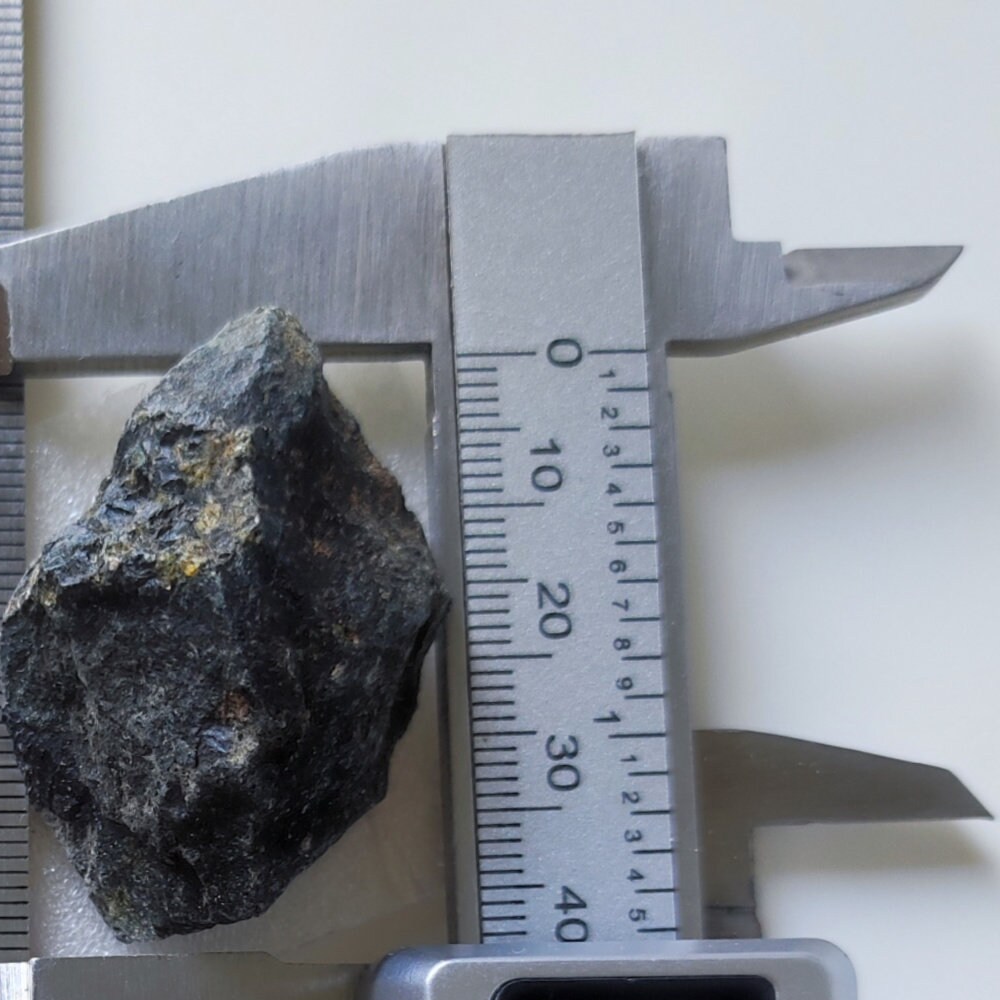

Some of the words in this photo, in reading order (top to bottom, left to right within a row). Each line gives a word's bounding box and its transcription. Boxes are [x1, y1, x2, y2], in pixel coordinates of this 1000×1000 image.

[546, 337, 584, 369] 0
[598, 368, 617, 379] 1
[601, 406, 619, 420] 2
[602, 444, 621, 458] 3
[529, 438, 564, 493] 10
[605, 482, 623, 496] 4
[606, 520, 625, 535] 5
[609, 559, 627, 574] 6
[536, 581, 573, 640] 20
[611, 598, 630, 612] 7
[613, 637, 632, 651] 8
[615, 676, 634, 691] 9
[593, 710, 622, 723] 1
[545, 734, 582, 792] 30
[620, 754, 638, 763] 1
[621, 791, 641, 805] 2
[623, 829, 643, 843] 3
[626, 868, 646, 882] 4
[553, 885, 590, 943] 40
[628, 908, 647, 922] 5
